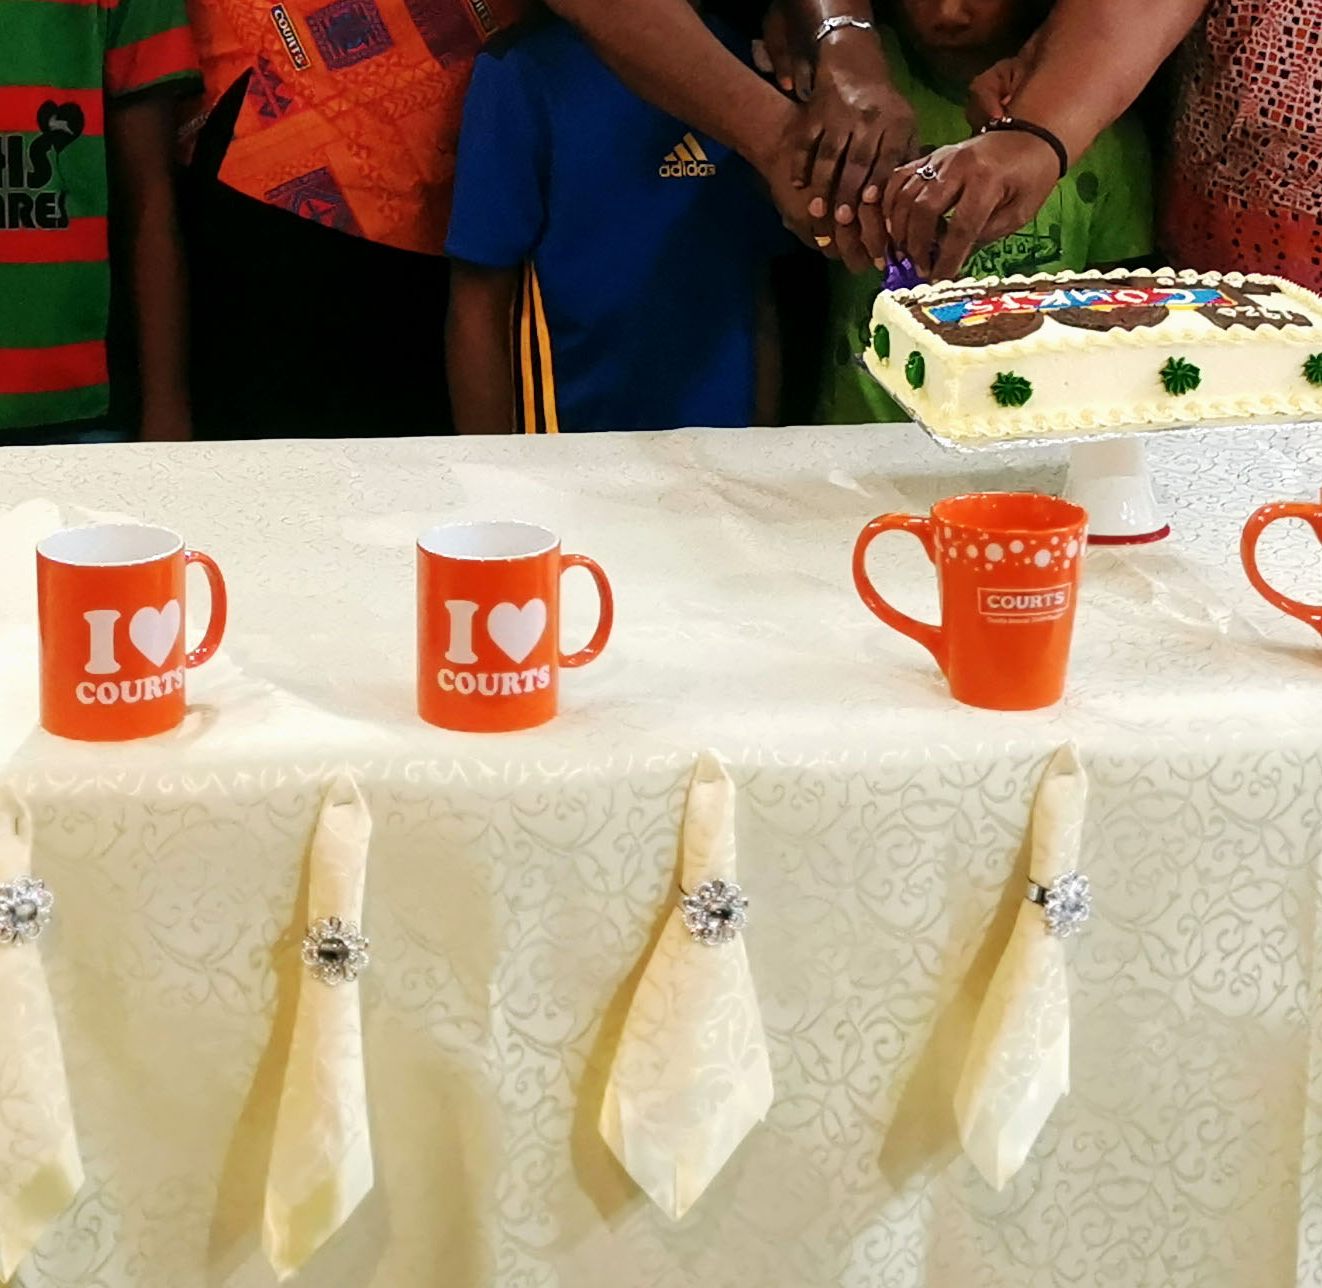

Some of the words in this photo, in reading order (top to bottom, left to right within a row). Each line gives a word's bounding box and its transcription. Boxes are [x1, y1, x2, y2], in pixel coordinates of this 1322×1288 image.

[274, 9, 305, 65] COURTS
[659, 160, 717, 178] adidas
[987, 591, 1066, 610] COURTS
[83, 608, 121, 675] I
[443, 599, 480, 665] I
[76, 667, 186, 706] COURTS
[437, 665, 551, 697] COURTS
